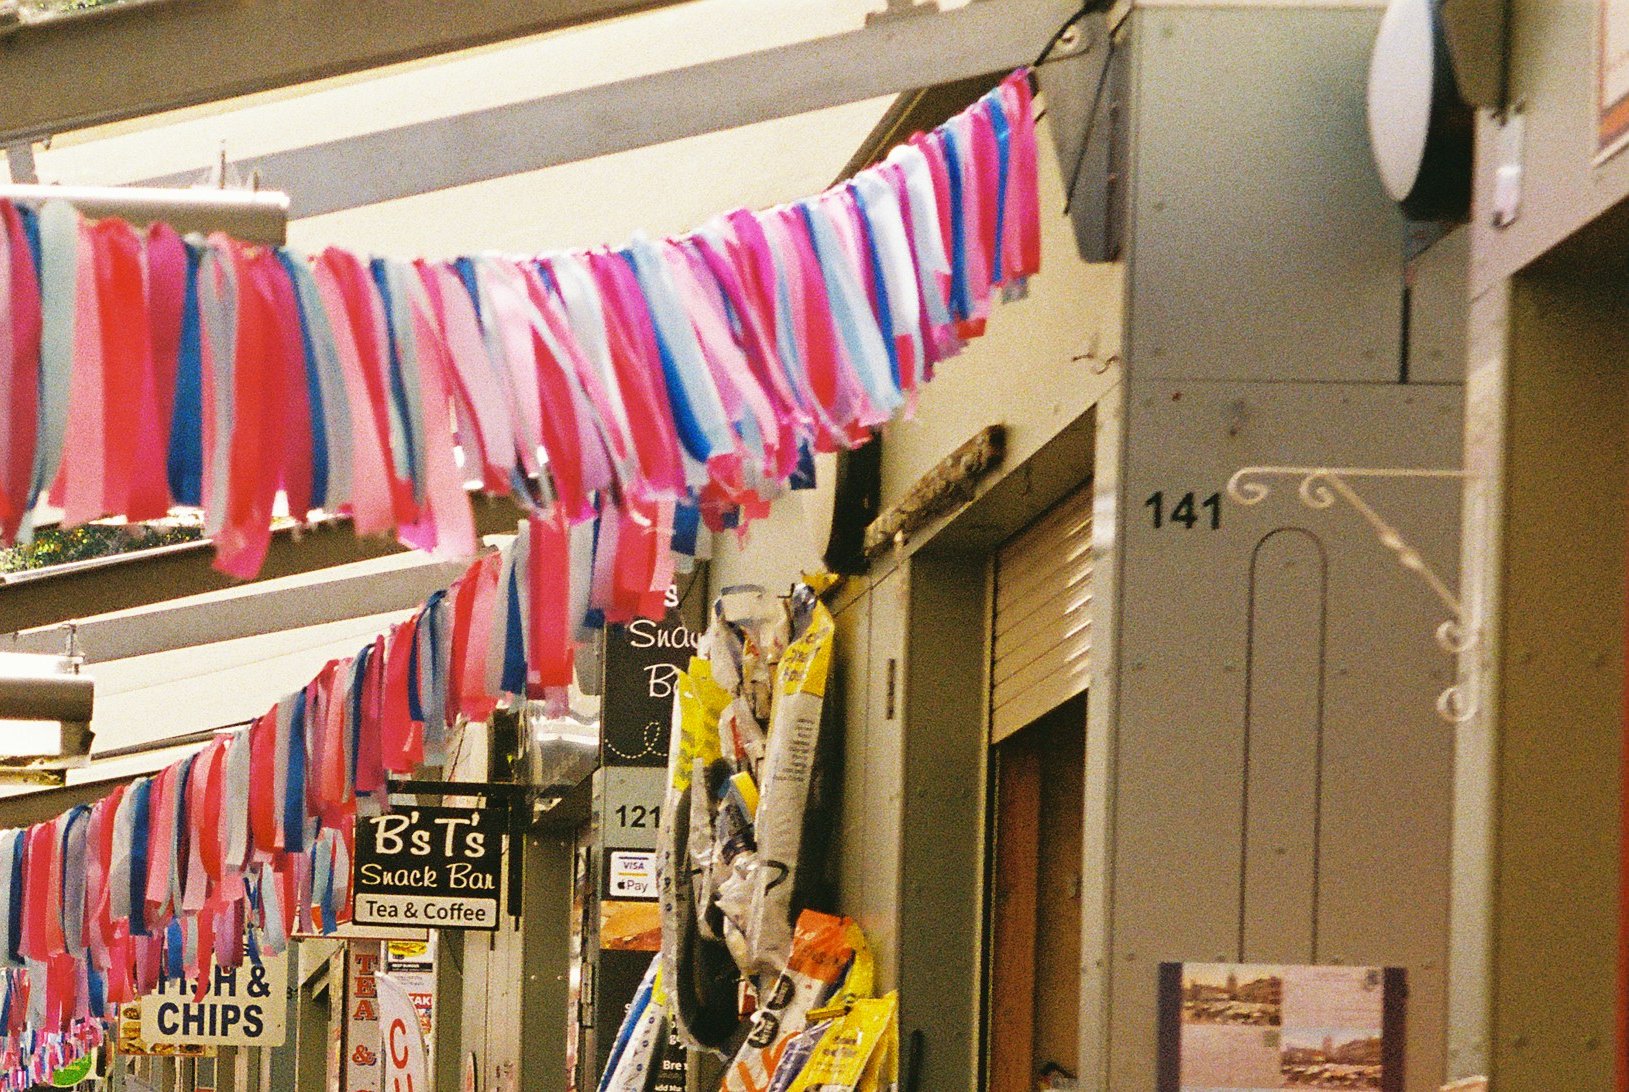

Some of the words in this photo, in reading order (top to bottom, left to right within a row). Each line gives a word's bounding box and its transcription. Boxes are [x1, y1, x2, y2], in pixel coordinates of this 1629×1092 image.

[1145, 491, 1220, 530] 141
[615, 804, 661, 828] 121
[370, 811, 431, 856] B's
[434, 813, 486, 858] T's
[360, 862, 439, 888] Snack
[445, 862, 496, 891] Bar
[622, 860, 645, 871] VISA
[626, 878, 649, 894] Pay
[366, 900, 398, 918] Tea
[404, 902, 418, 919] &
[423, 902, 486, 921] Coffee
[247, 965, 271, 998] &
[354, 954, 377, 1020] TEA
[157, 1002, 264, 1037] CHIPS
[351, 1044, 377, 1066] &
